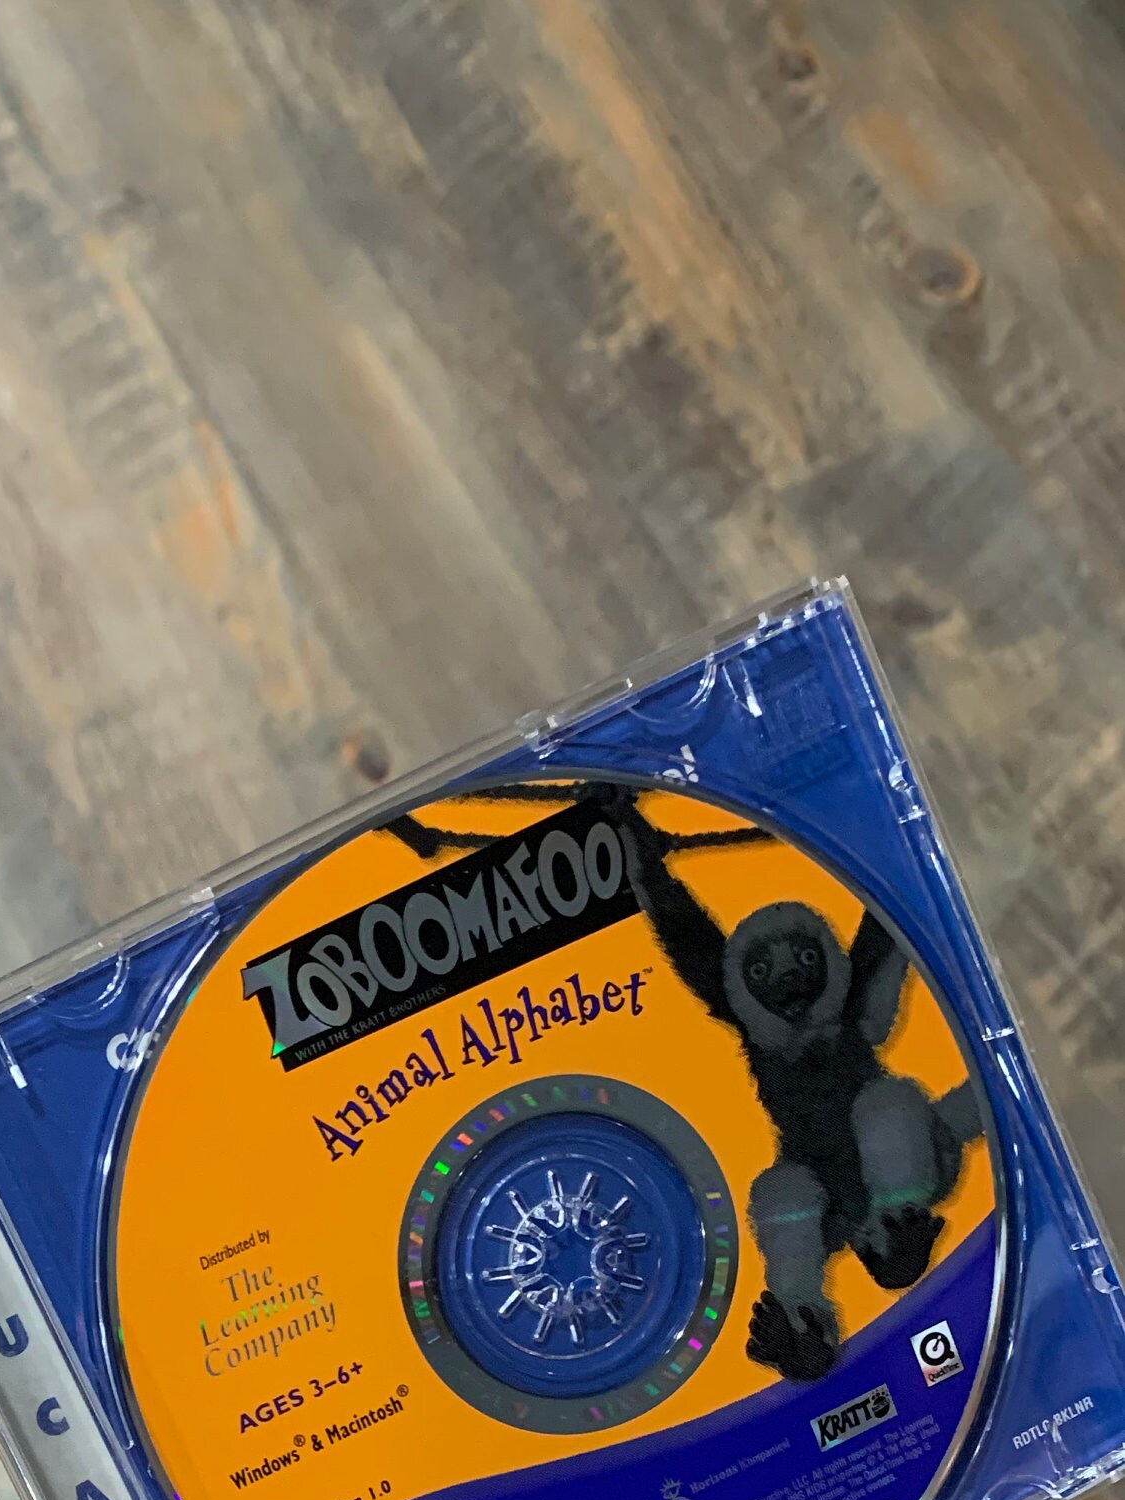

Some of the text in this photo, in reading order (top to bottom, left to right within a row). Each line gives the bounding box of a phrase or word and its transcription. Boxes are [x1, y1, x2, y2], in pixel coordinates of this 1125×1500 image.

[294, 984, 447, 1061] WITH THE KRATT BROTHERS
[312, 1029, 455, 1162] Animal
[200, 1229, 271, 1270] Distributed by
[221, 1266, 274, 1302] The
[199, 1274, 324, 1347] Learning
[204, 1302, 336, 1377] Company
[239, 1387, 305, 1434] AGES
[818, 1398, 872, 1447] KRATT
[310, 1433, 325, 1452] &
[369, 1480, 392, 1500] 1.0
[690, 1461, 739, 1494] Horizons
